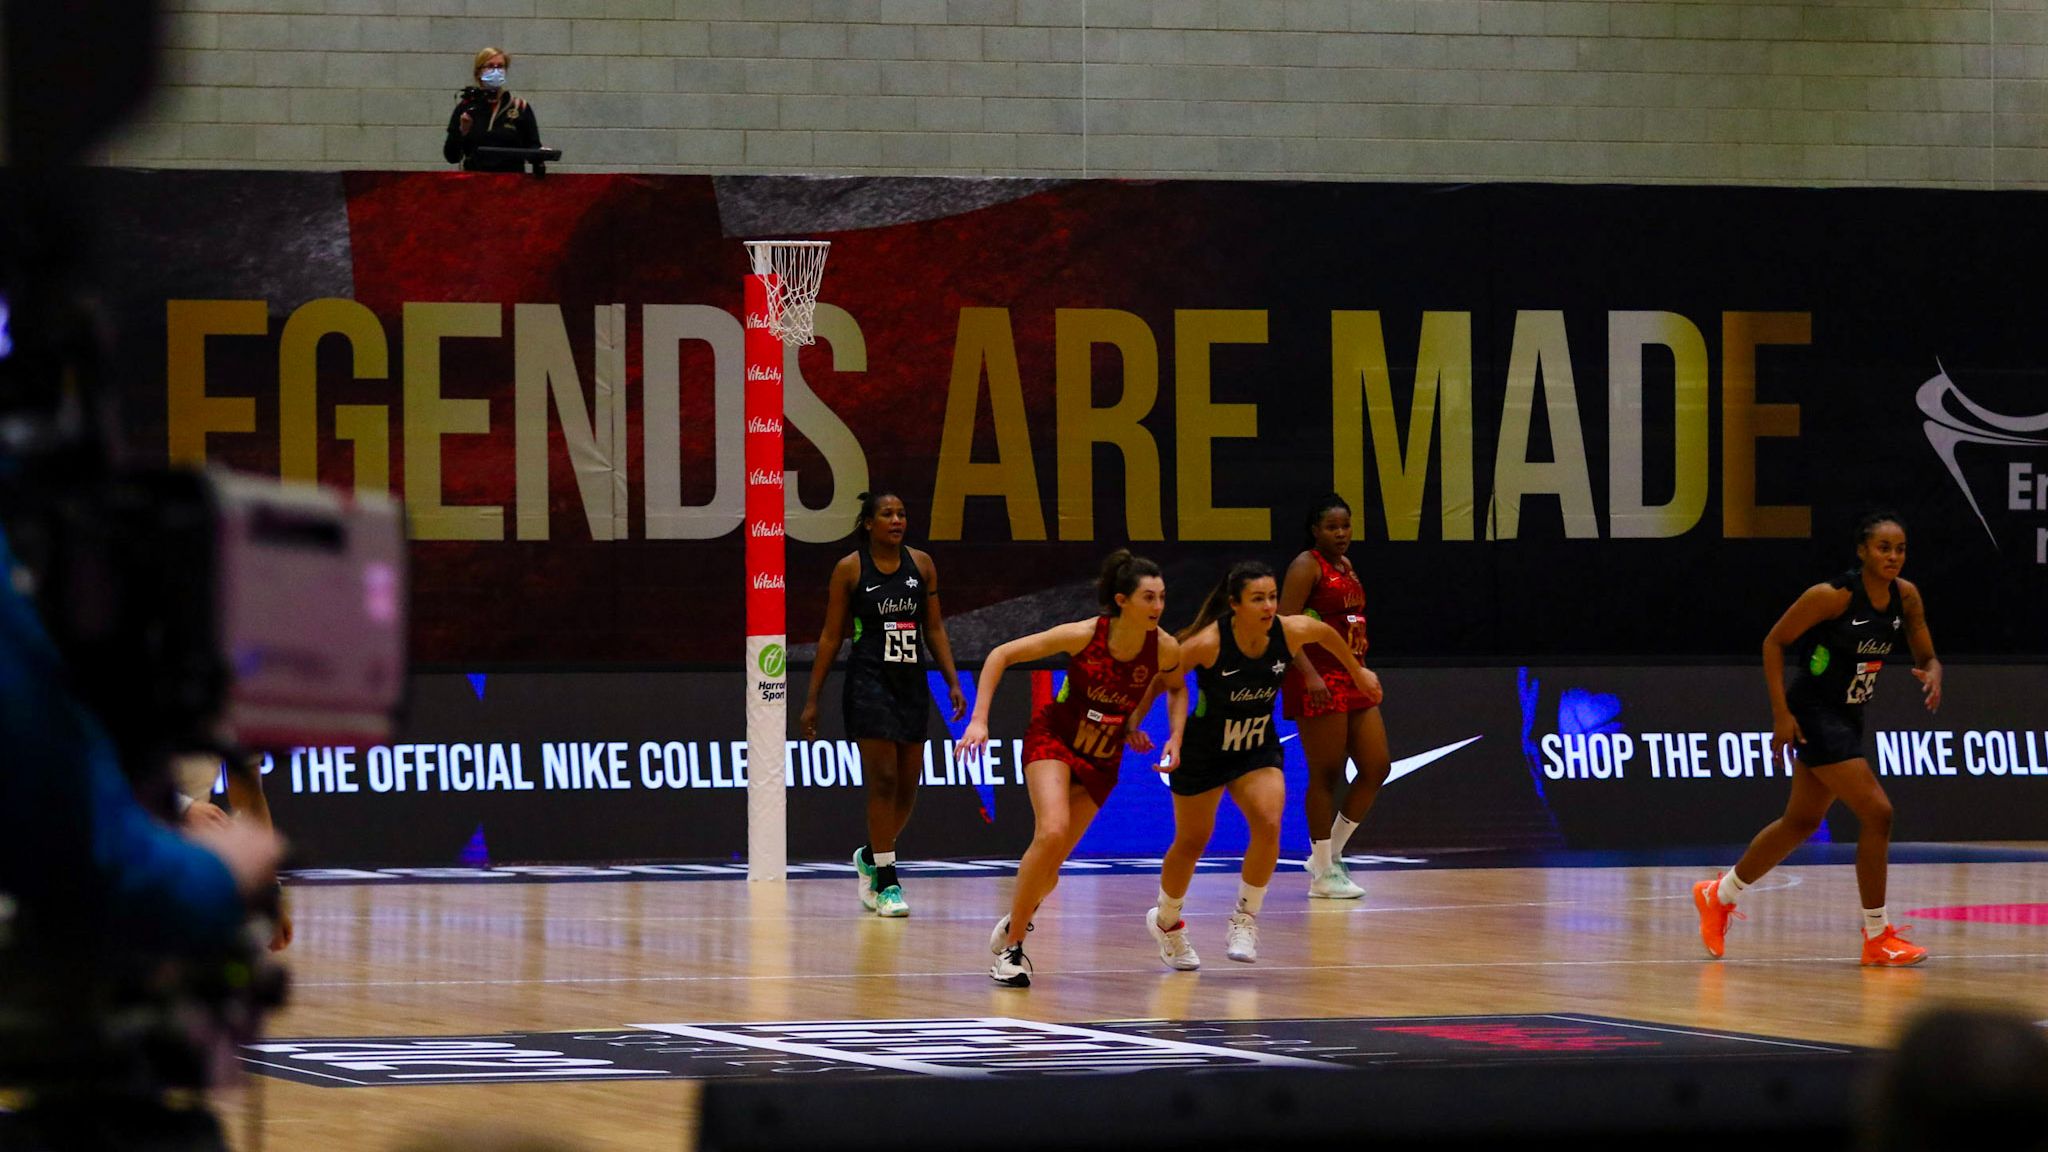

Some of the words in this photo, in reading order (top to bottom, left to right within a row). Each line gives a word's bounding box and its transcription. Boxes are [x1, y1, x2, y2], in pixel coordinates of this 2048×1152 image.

[747, 363, 782, 386] Vitality
[748, 416, 783, 438] Vitality
[929, 306, 1272, 541] ARE
[1331, 309, 1812, 541] MADE
[750, 468, 784, 489] Vitality
[877, 597, 917, 615] Vitality
[884, 629, 918, 663] GS
[1230, 687, 1276, 702] Vitality
[1221, 714, 1271, 752] WA
[289, 746, 360, 793] THE
[367, 743, 535, 792] OFFICIAL
[542, 742, 631, 790] NIKE
[639, 740, 864, 789] COLLETION
[1540, 733, 1634, 780] SHOP
[1641, 732, 1712, 779] THE
[1876, 731, 1957, 776] NIKE
[1963, 730, 2048, 776] COLL
